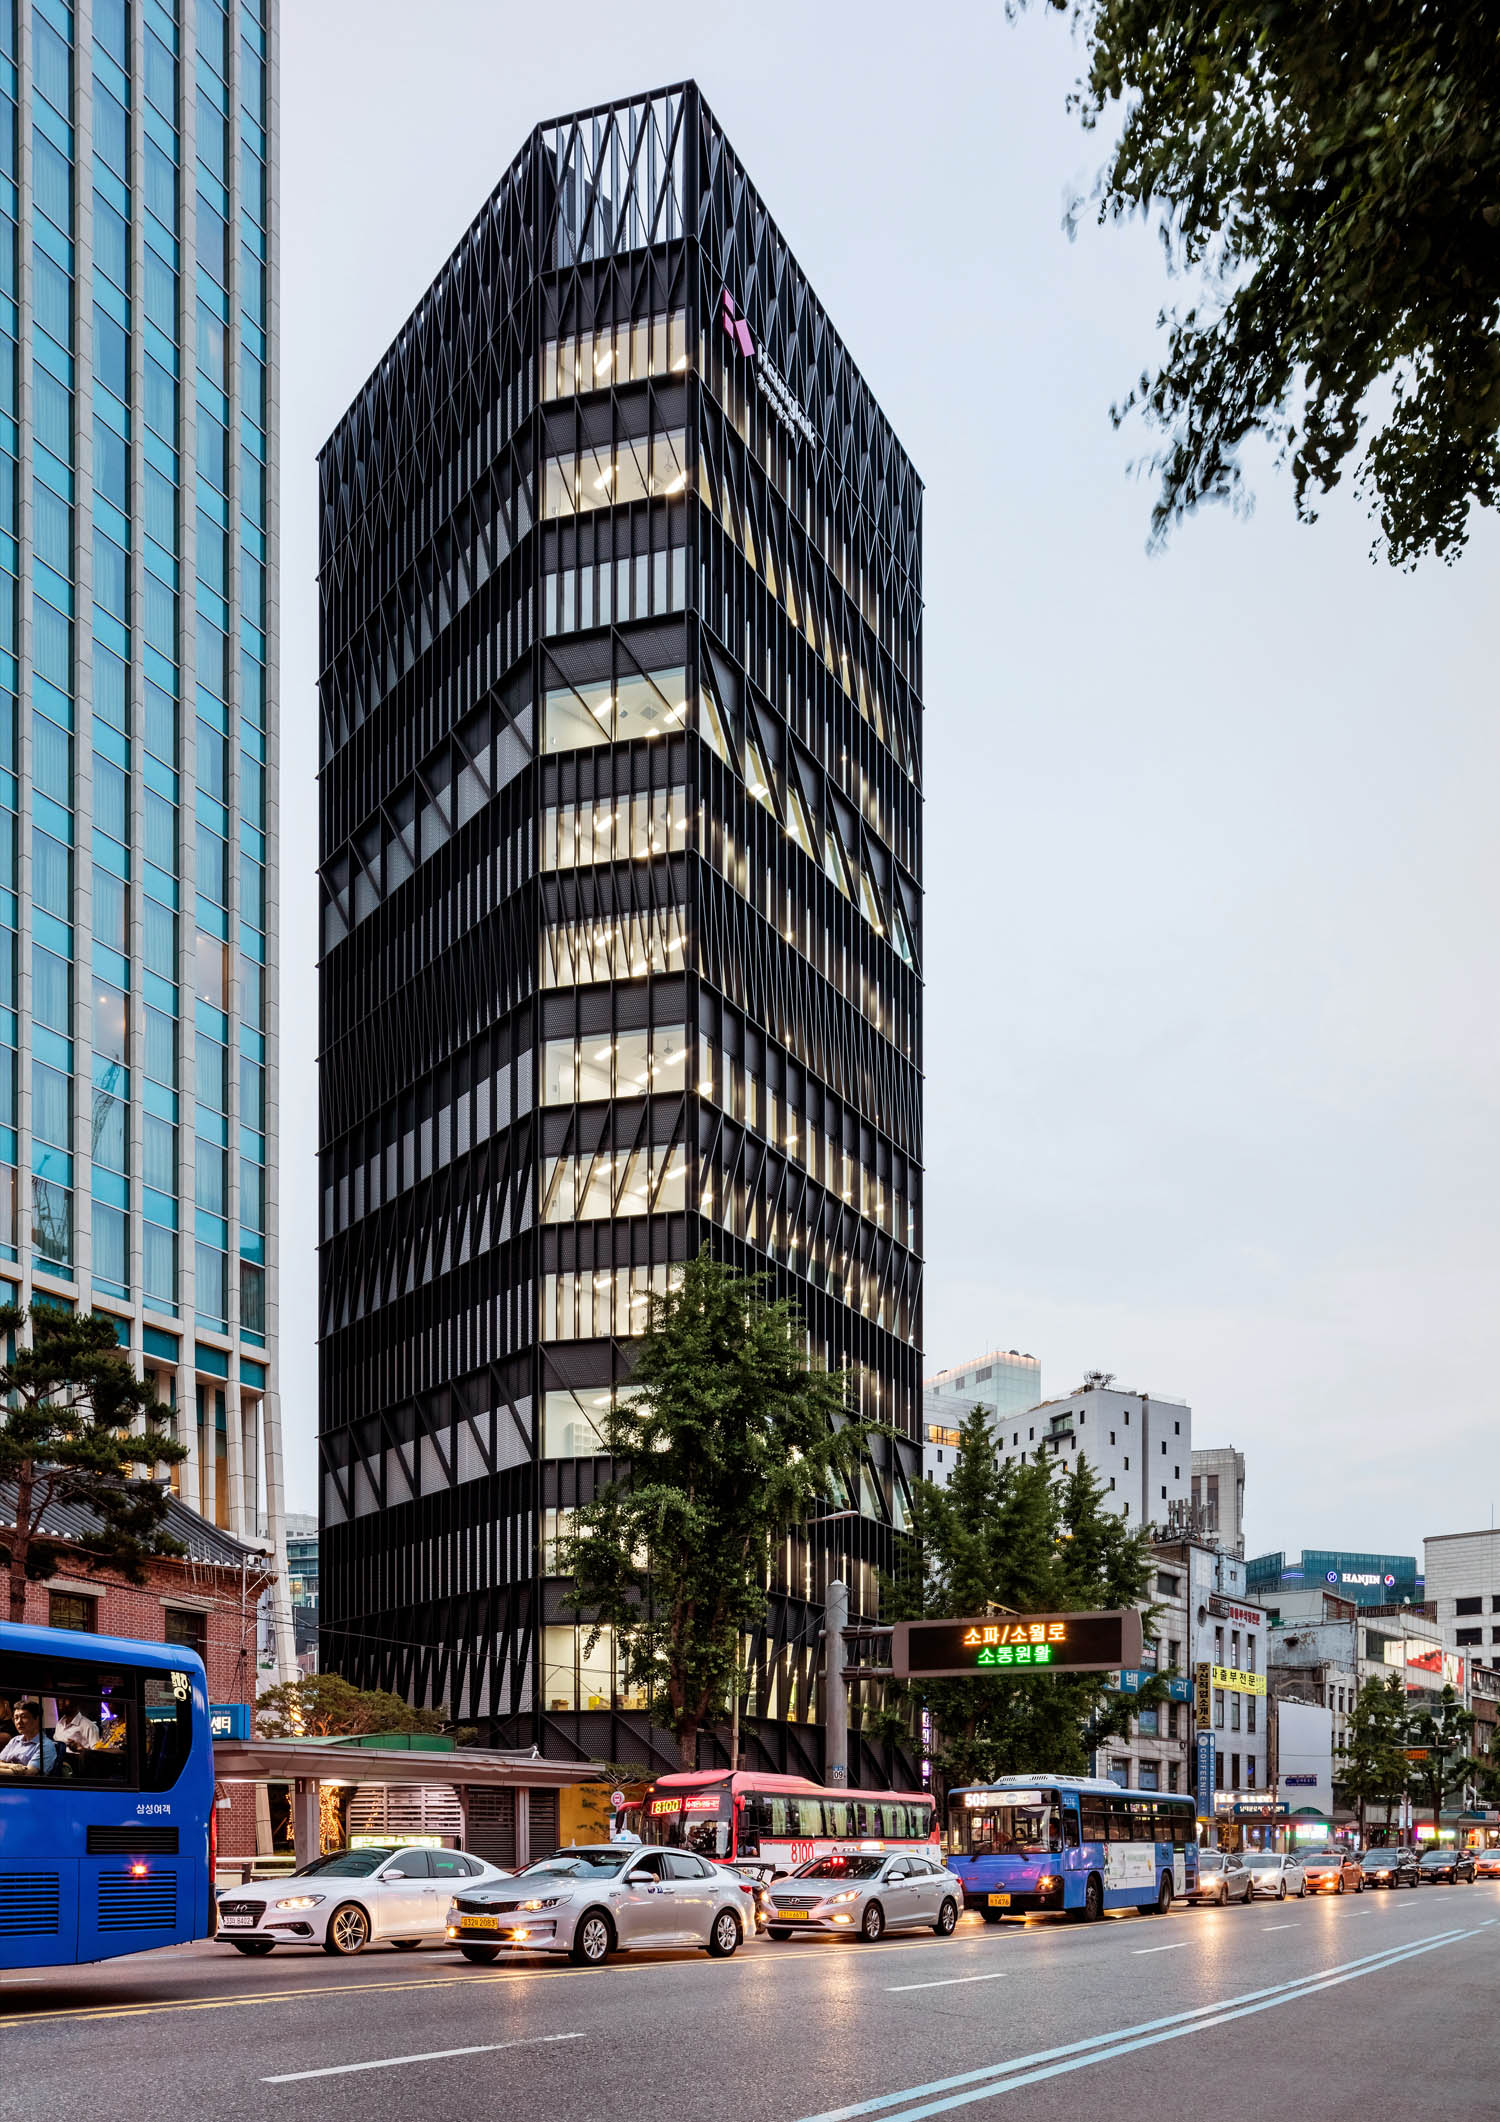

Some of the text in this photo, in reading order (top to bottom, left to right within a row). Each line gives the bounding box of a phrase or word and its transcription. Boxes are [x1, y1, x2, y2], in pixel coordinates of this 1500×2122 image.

[1342, 1573, 1380, 1586] HANJIN
[964, 1623, 1066, 1645] 소파/소월로
[977, 1645, 1052, 1664] 소통원활
[1125, 1671, 1188, 1698] 백과
[1212, 1667, 1256, 1687] 파출부전문
[1199, 1664, 1208, 1724] 우신직업소개소
[210, 1716, 231, 1735] 센터
[834, 1771, 843, 1779] 09
[136, 1804, 171, 1815] 삼성여객
[655, 1800, 680, 1814] 8100
[964, 1793, 988, 1807] 505
[791, 1842, 815, 1864] 8100
